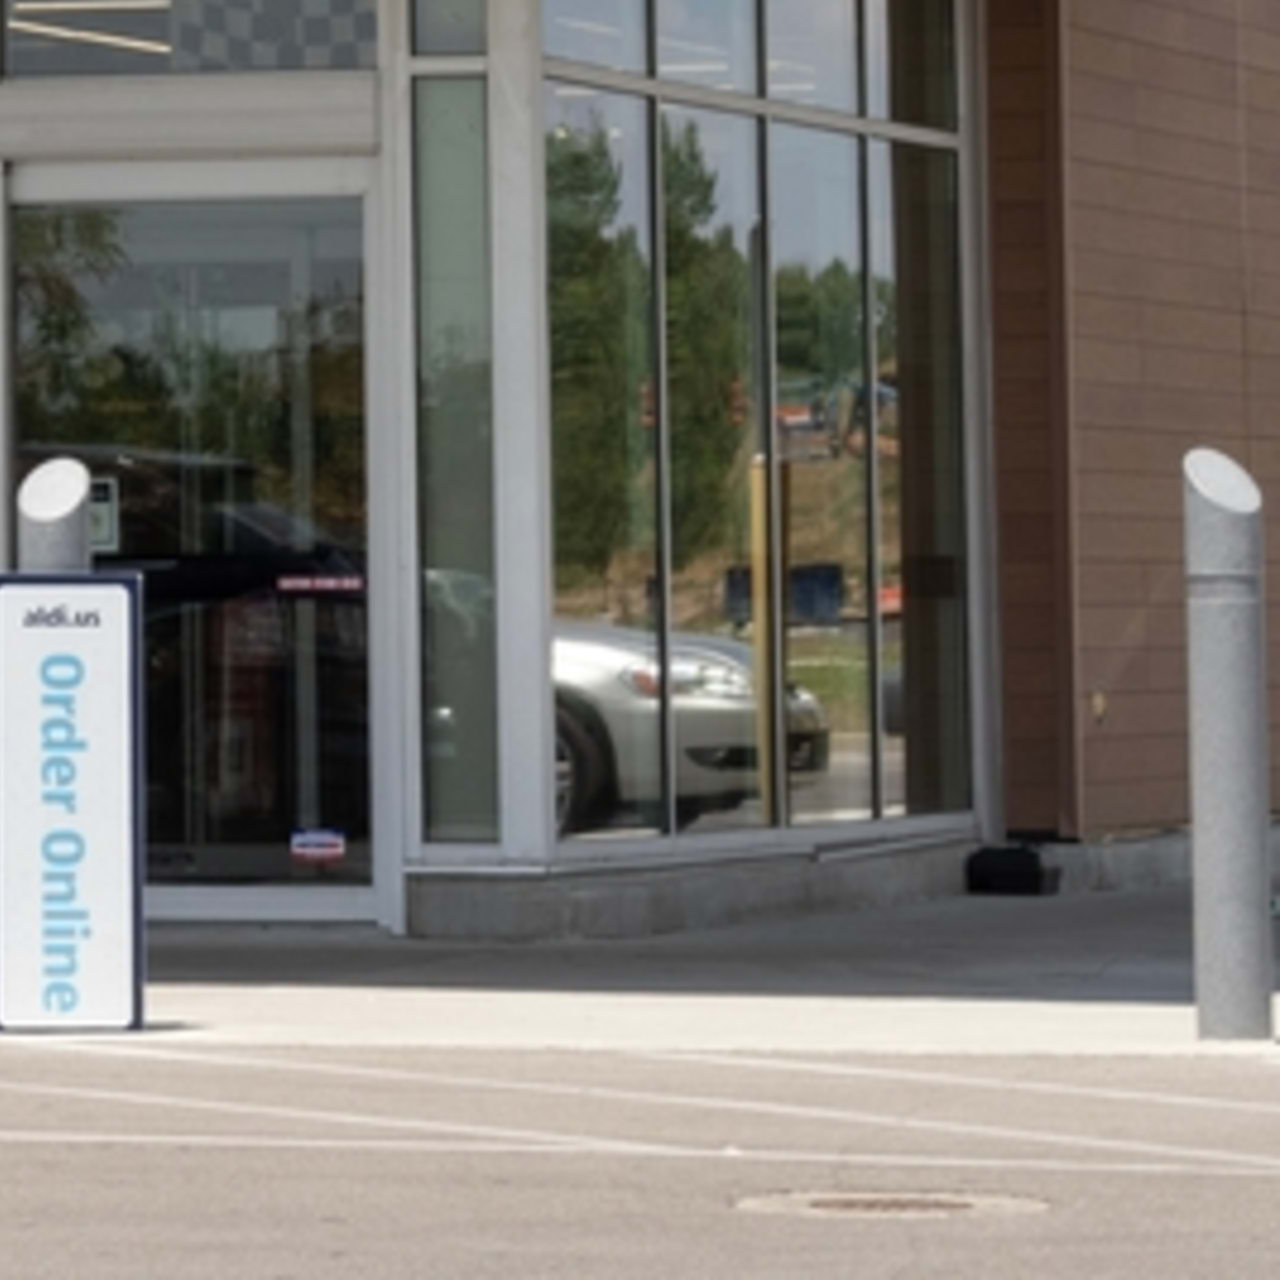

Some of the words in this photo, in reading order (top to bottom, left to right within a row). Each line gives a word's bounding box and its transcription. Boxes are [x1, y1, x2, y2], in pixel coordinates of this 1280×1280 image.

[22, 605, 101, 628] aldi.us
[38, 653, 88, 813] Order
[40, 829, 93, 1013] Online
